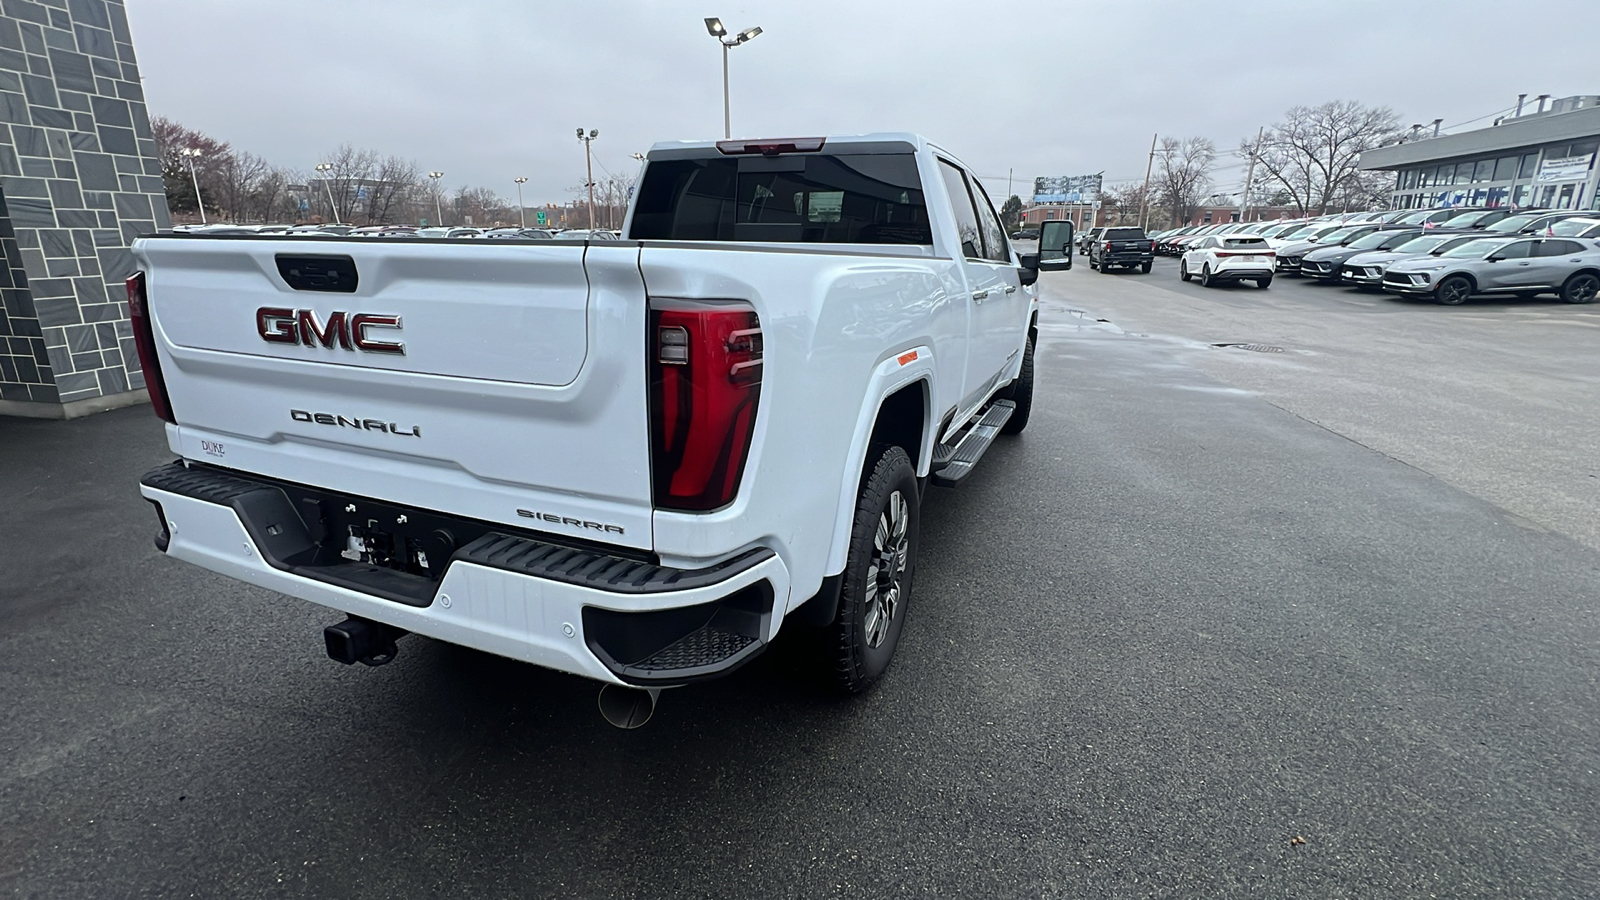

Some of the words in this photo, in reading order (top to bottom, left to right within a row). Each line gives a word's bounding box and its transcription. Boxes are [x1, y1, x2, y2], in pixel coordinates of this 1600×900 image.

[256, 306, 406, 356] GMC
[290, 409, 421, 438] DENALI
[201, 440, 225, 454] DUKE
[516, 508, 625, 534] SIERRA
